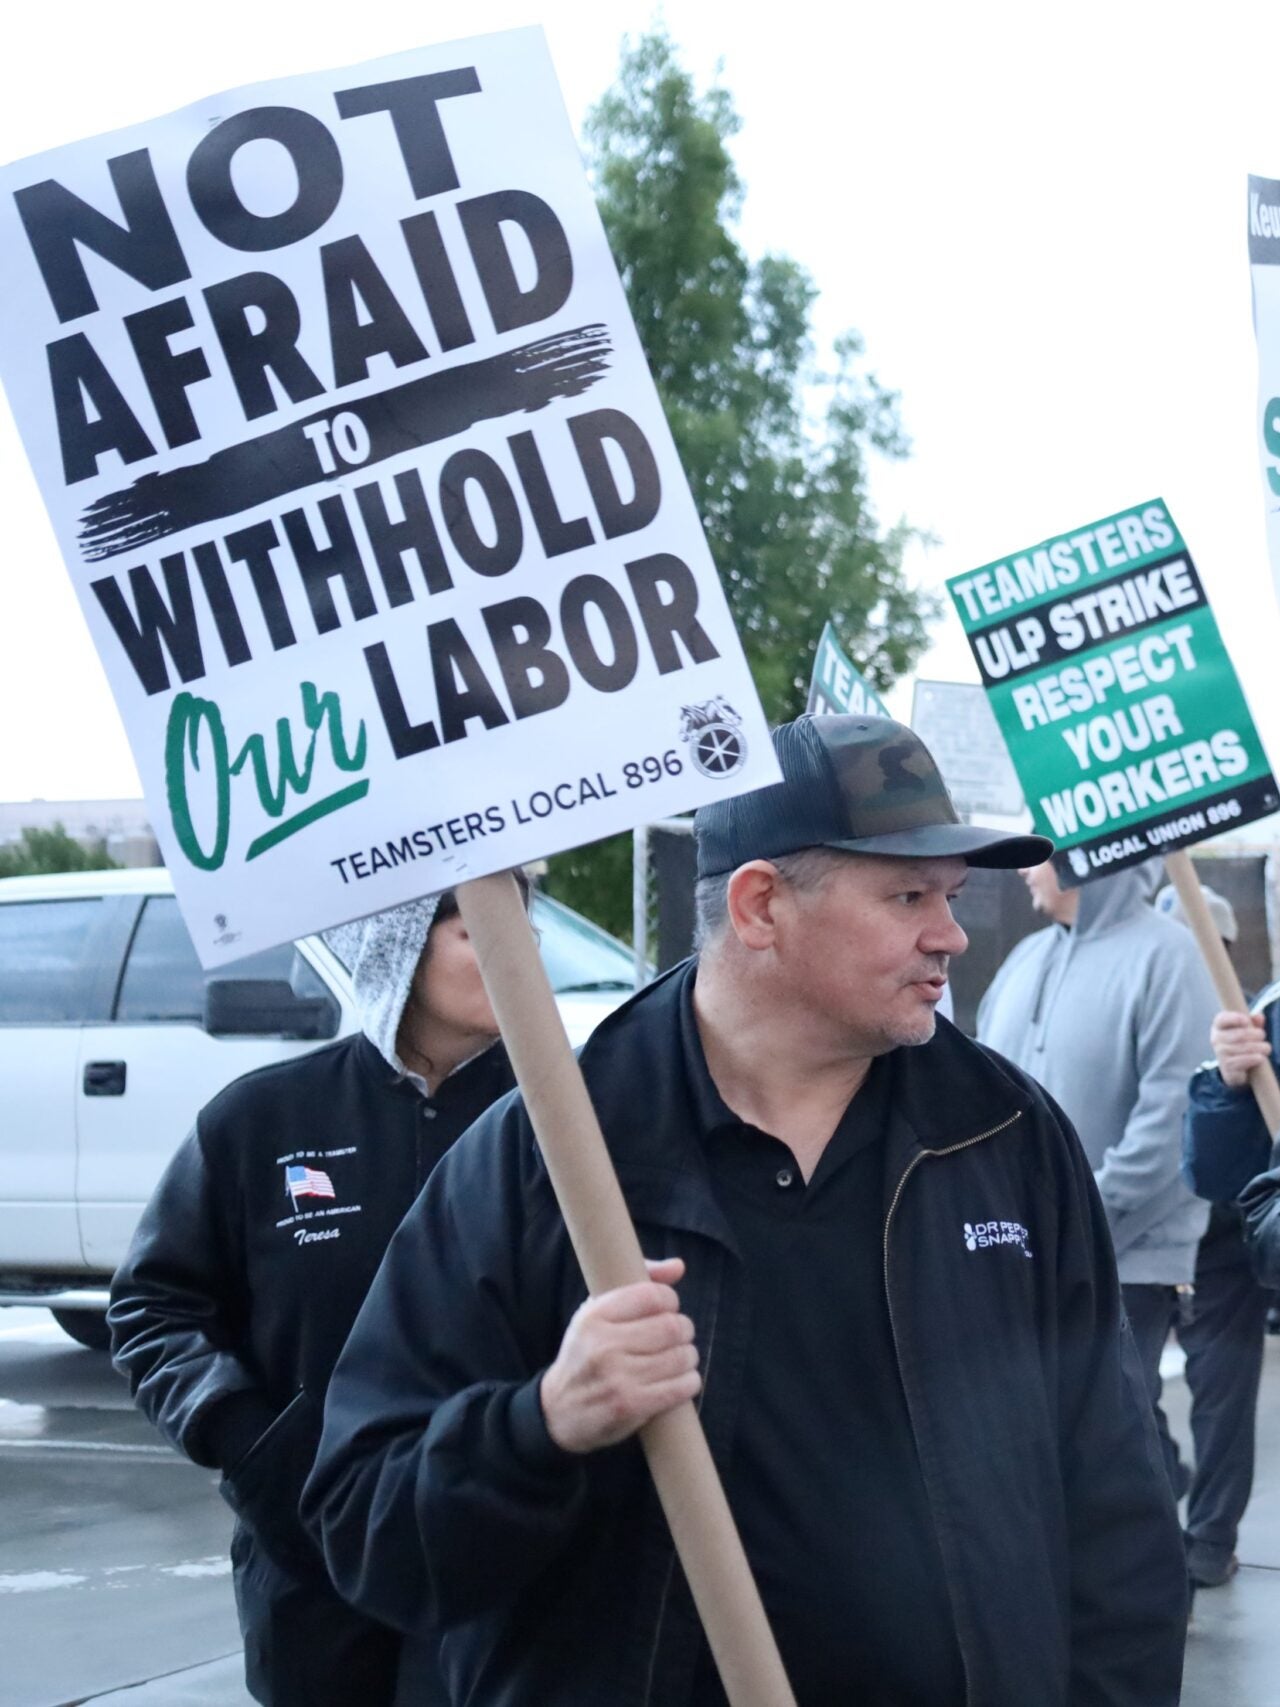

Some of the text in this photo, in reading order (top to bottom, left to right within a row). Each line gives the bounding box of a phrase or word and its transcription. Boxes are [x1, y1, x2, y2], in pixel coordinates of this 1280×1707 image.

[14, 66, 481, 324] NOT
[46, 189, 574, 486] AFRAID
[304, 411, 371, 474] TO
[91, 408, 661, 696] WITHHOLD
[953, 506, 1176, 622] TEAMSTERS
[975, 560, 1199, 679] ULP STRIKE
[166, 681, 367, 871] Our
[364, 553, 720, 760] LABOR
[1012, 625, 1197, 731] RESPECT
[1062, 694, 1184, 771] YOUR
[331, 750, 682, 884] TEAMSTERS LOCAL 896
[1040, 730, 1249, 838] WORKERS
[1089, 799, 1242, 868] LOCAL UNION 896
[294, 1228, 341, 1246] Teresa
[975, 1221, 999, 1236] DR
